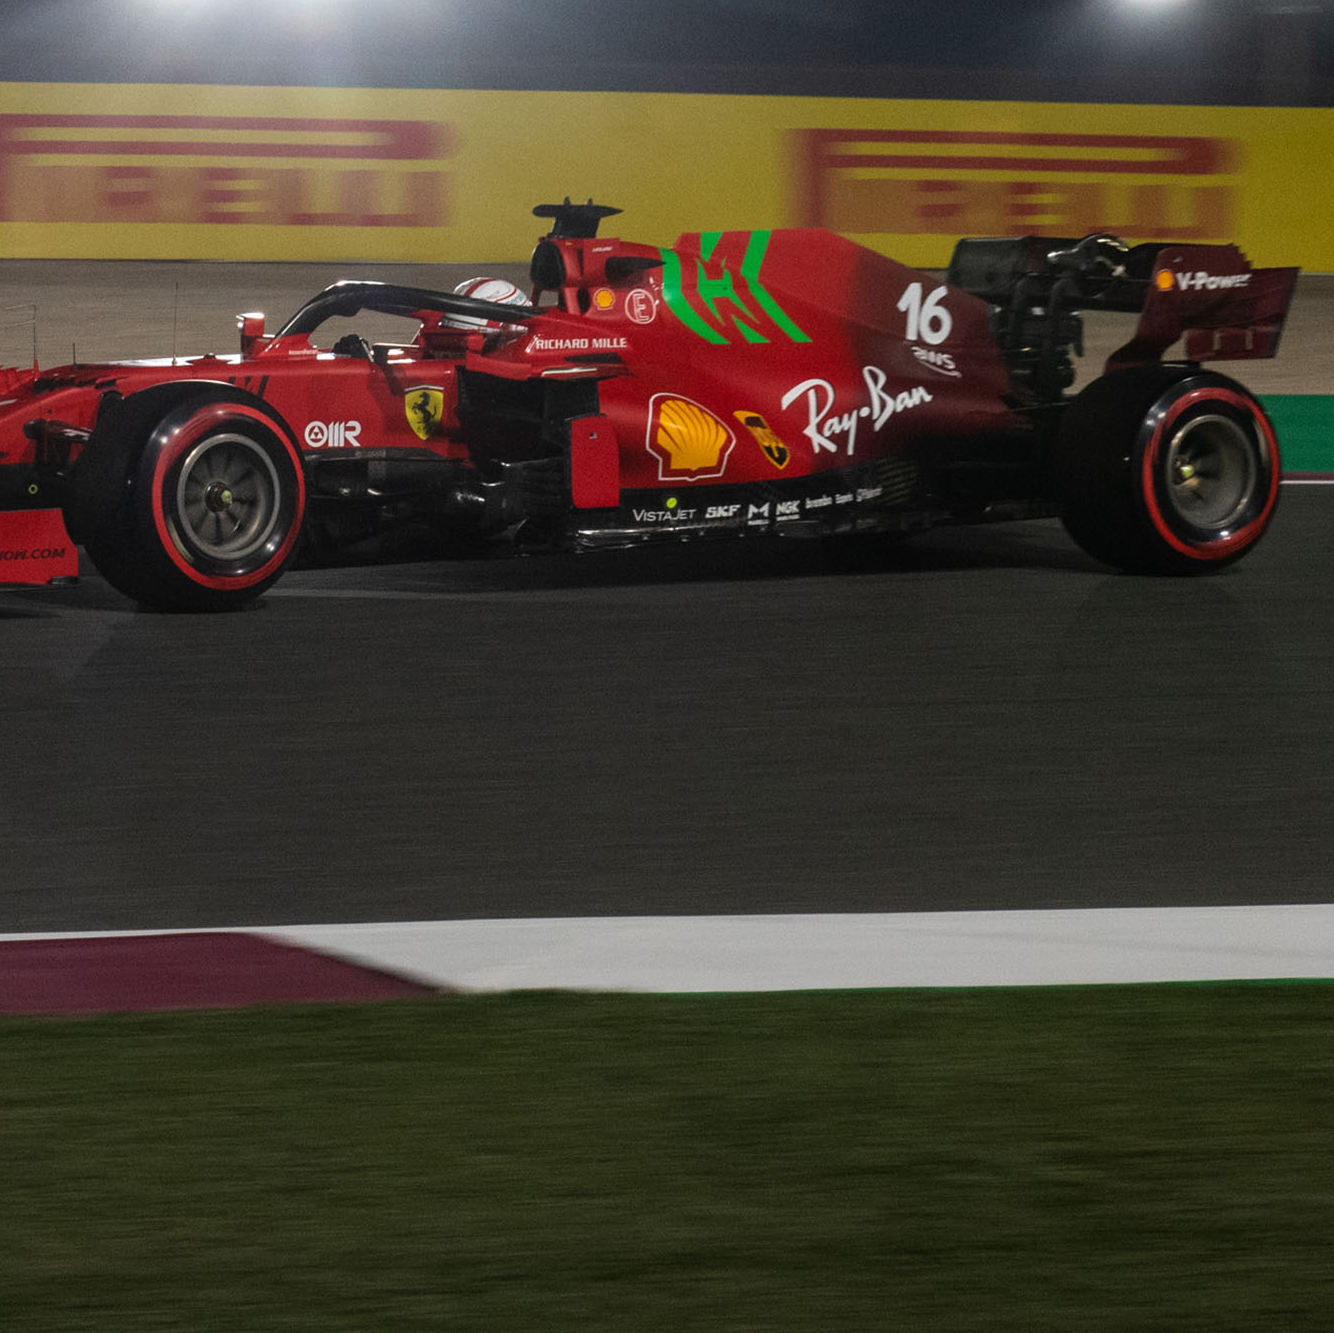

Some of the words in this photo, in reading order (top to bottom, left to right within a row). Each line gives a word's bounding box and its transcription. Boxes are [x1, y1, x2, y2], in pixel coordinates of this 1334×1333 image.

[897, 282, 952, 345] 16
[535, 338, 589, 350] RICHARD
[592, 337, 628, 349] MILLE
[705, 504, 741, 518] SKF
[776, 500, 800, 515] NGK
